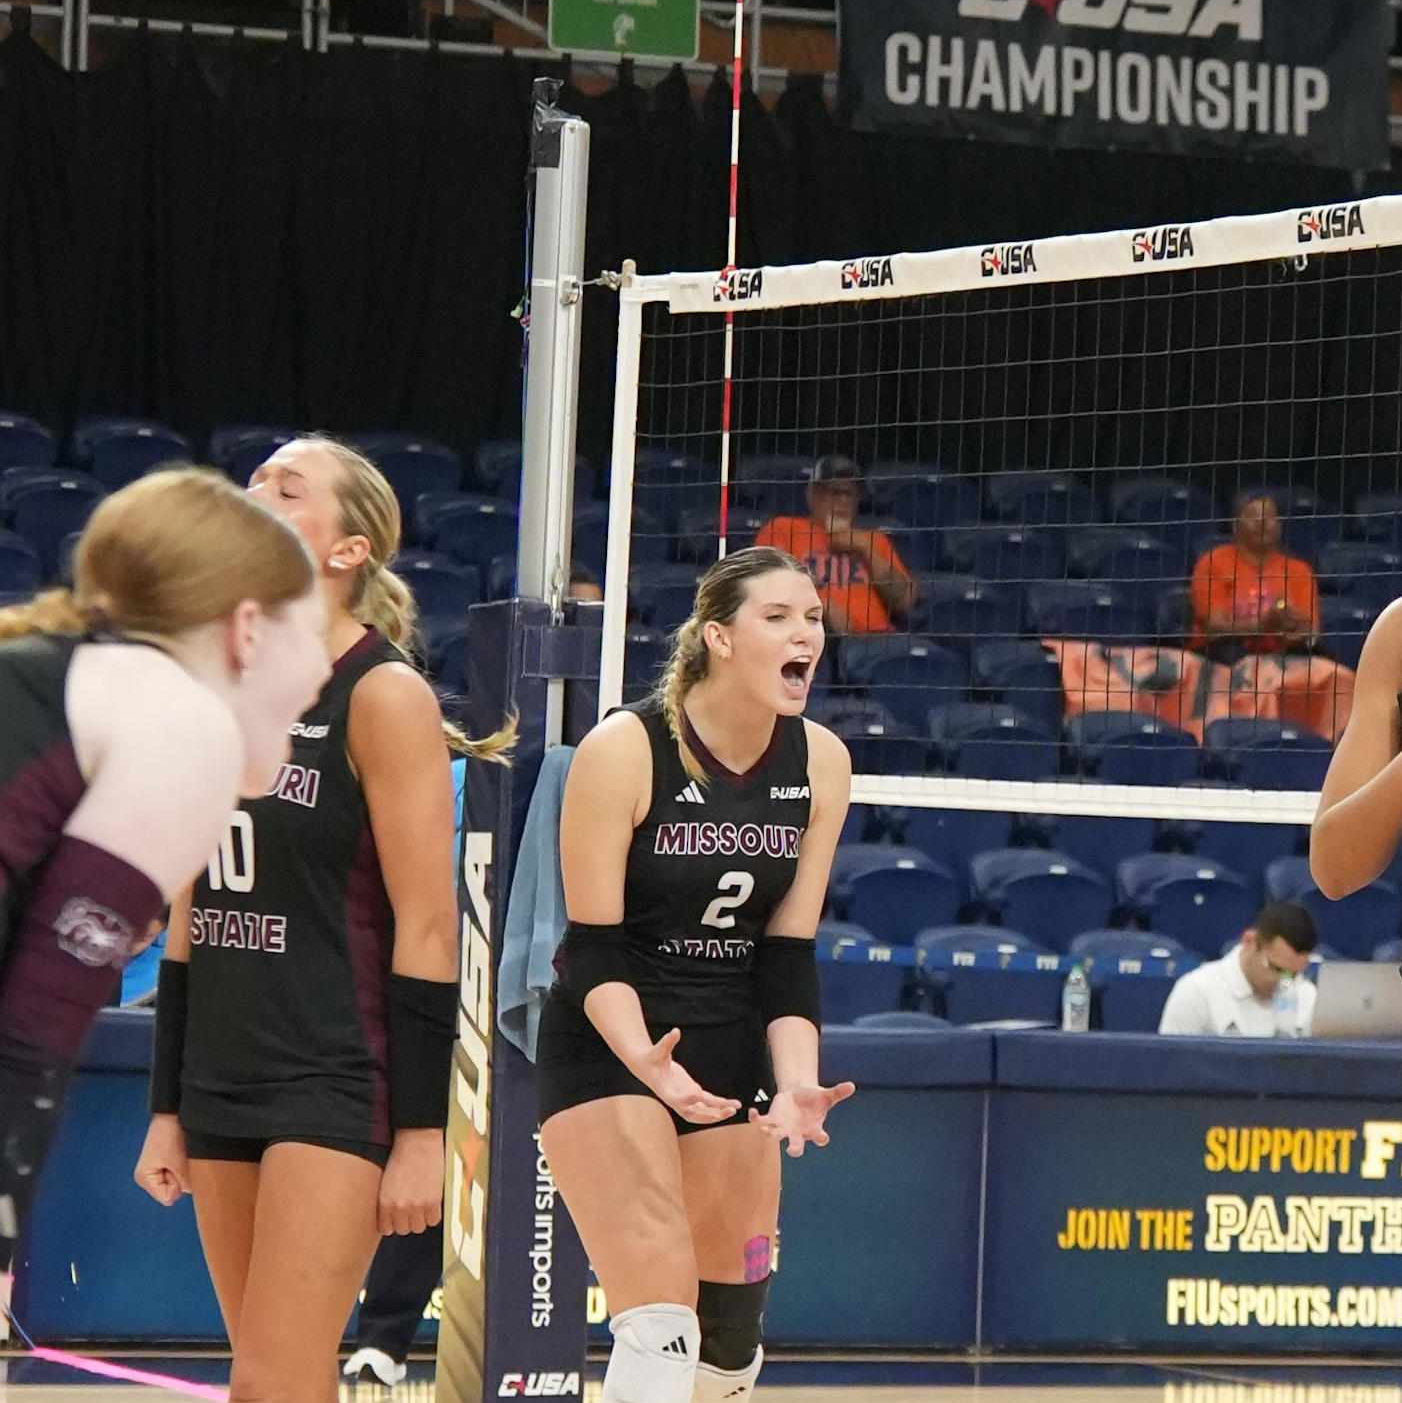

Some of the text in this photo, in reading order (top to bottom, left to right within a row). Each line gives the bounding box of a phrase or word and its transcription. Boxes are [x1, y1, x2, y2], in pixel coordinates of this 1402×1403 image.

[884, 32, 1330, 135] CHAMPIONSHIP
[654, 822, 805, 859] MISSOUR
[700, 870, 755, 929] 2
[190, 907, 287, 953] STATE
[657, 939, 755, 959] TAT
[1205, 1126, 1356, 1174] SUPPORT
[1057, 1208, 1130, 1251] JOIN
[1136, 1209, 1194, 1251] THE
